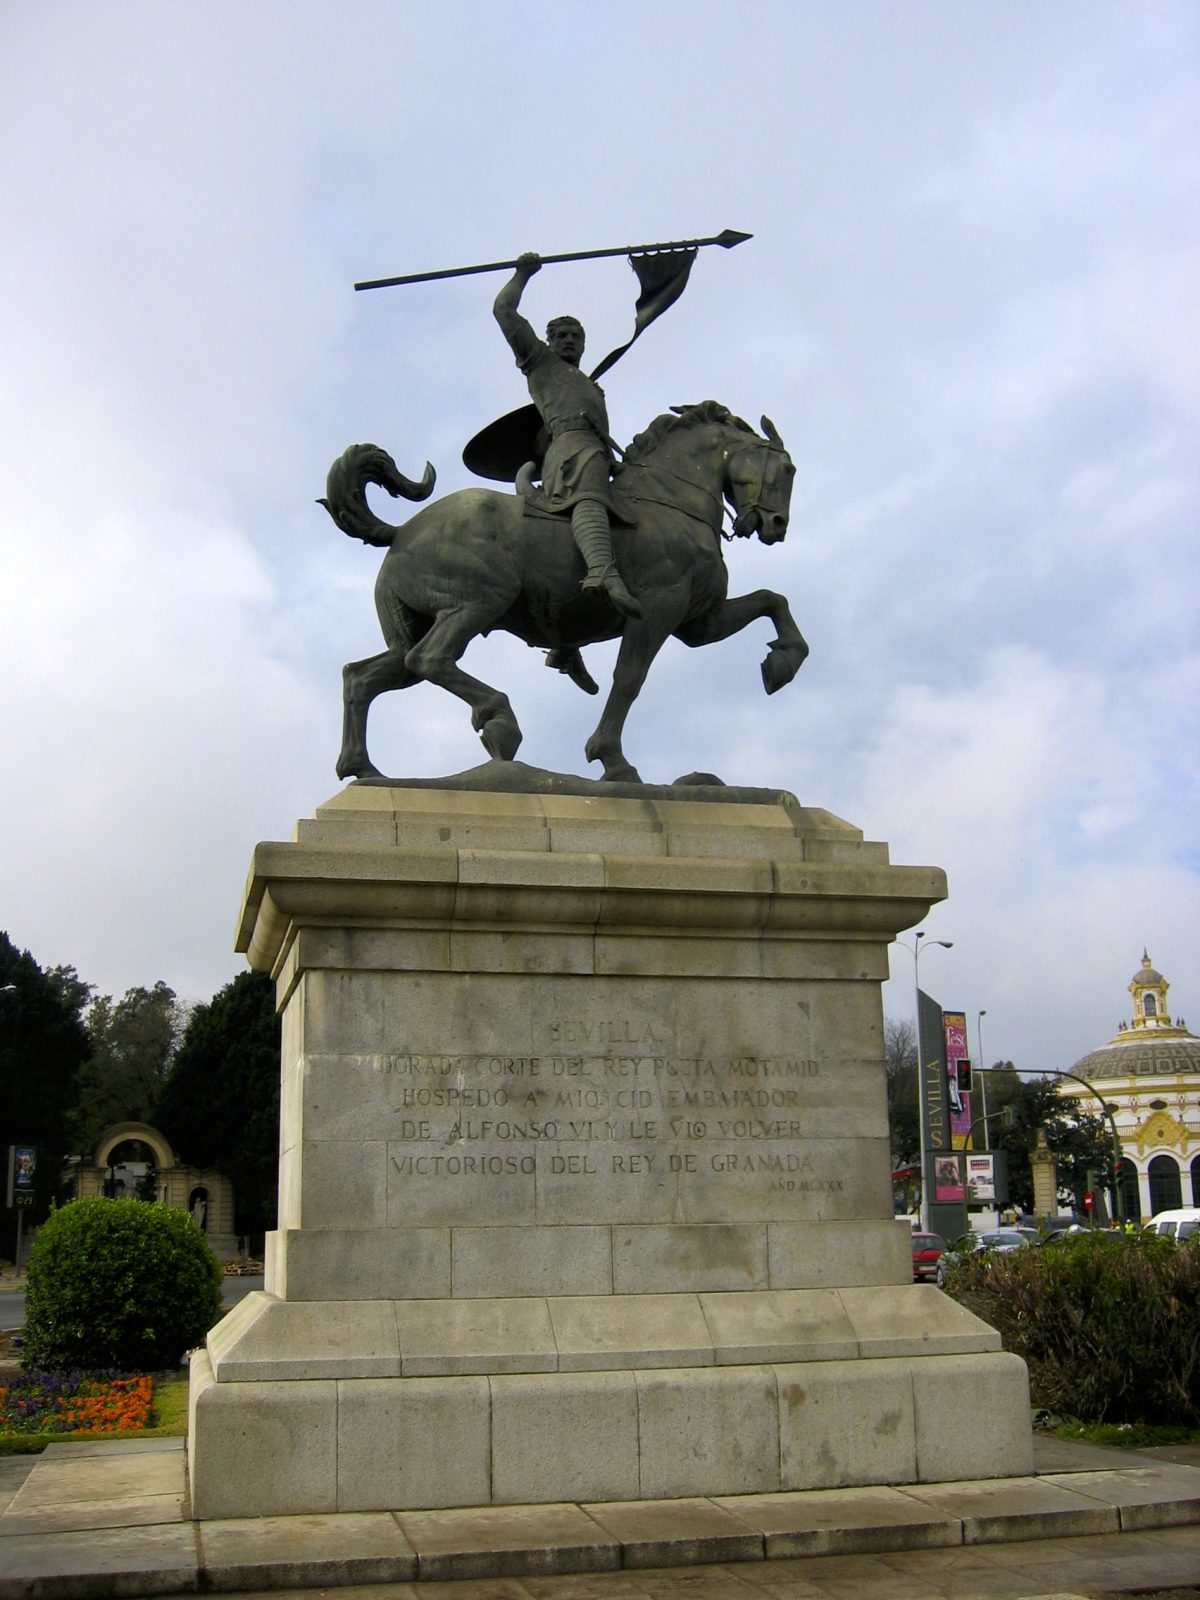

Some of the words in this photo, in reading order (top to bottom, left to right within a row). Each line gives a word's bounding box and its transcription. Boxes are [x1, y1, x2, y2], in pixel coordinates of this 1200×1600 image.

[381, 1055, 463, 1076] DORADA
[475, 1056, 540, 1076] CORTE
[552, 1057, 591, 1076] DEL
[603, 1057, 642, 1077] REY
[402, 1087, 509, 1108] HOSPEDO
[523, 1089, 539, 1108] A
[667, 1089, 800, 1108] EMBAJADOR
[927, 1060, 943, 1148] SEVILLA
[401, 1120, 431, 1140] DE
[449, 1121, 558, 1140] ALFONSO
[605, 1121, 618, 1139] Y
[630, 1121, 657, 1139] LE
[670, 1121, 707, 1138] VIO
[718, 1120, 803, 1139] VOLVER
[391, 1155, 537, 1175] VICTORIOSO
[551, 1155, 597, 1175] DEL
[612, 1155, 655, 1175] REY
[669, 1154, 698, 1173] DE
